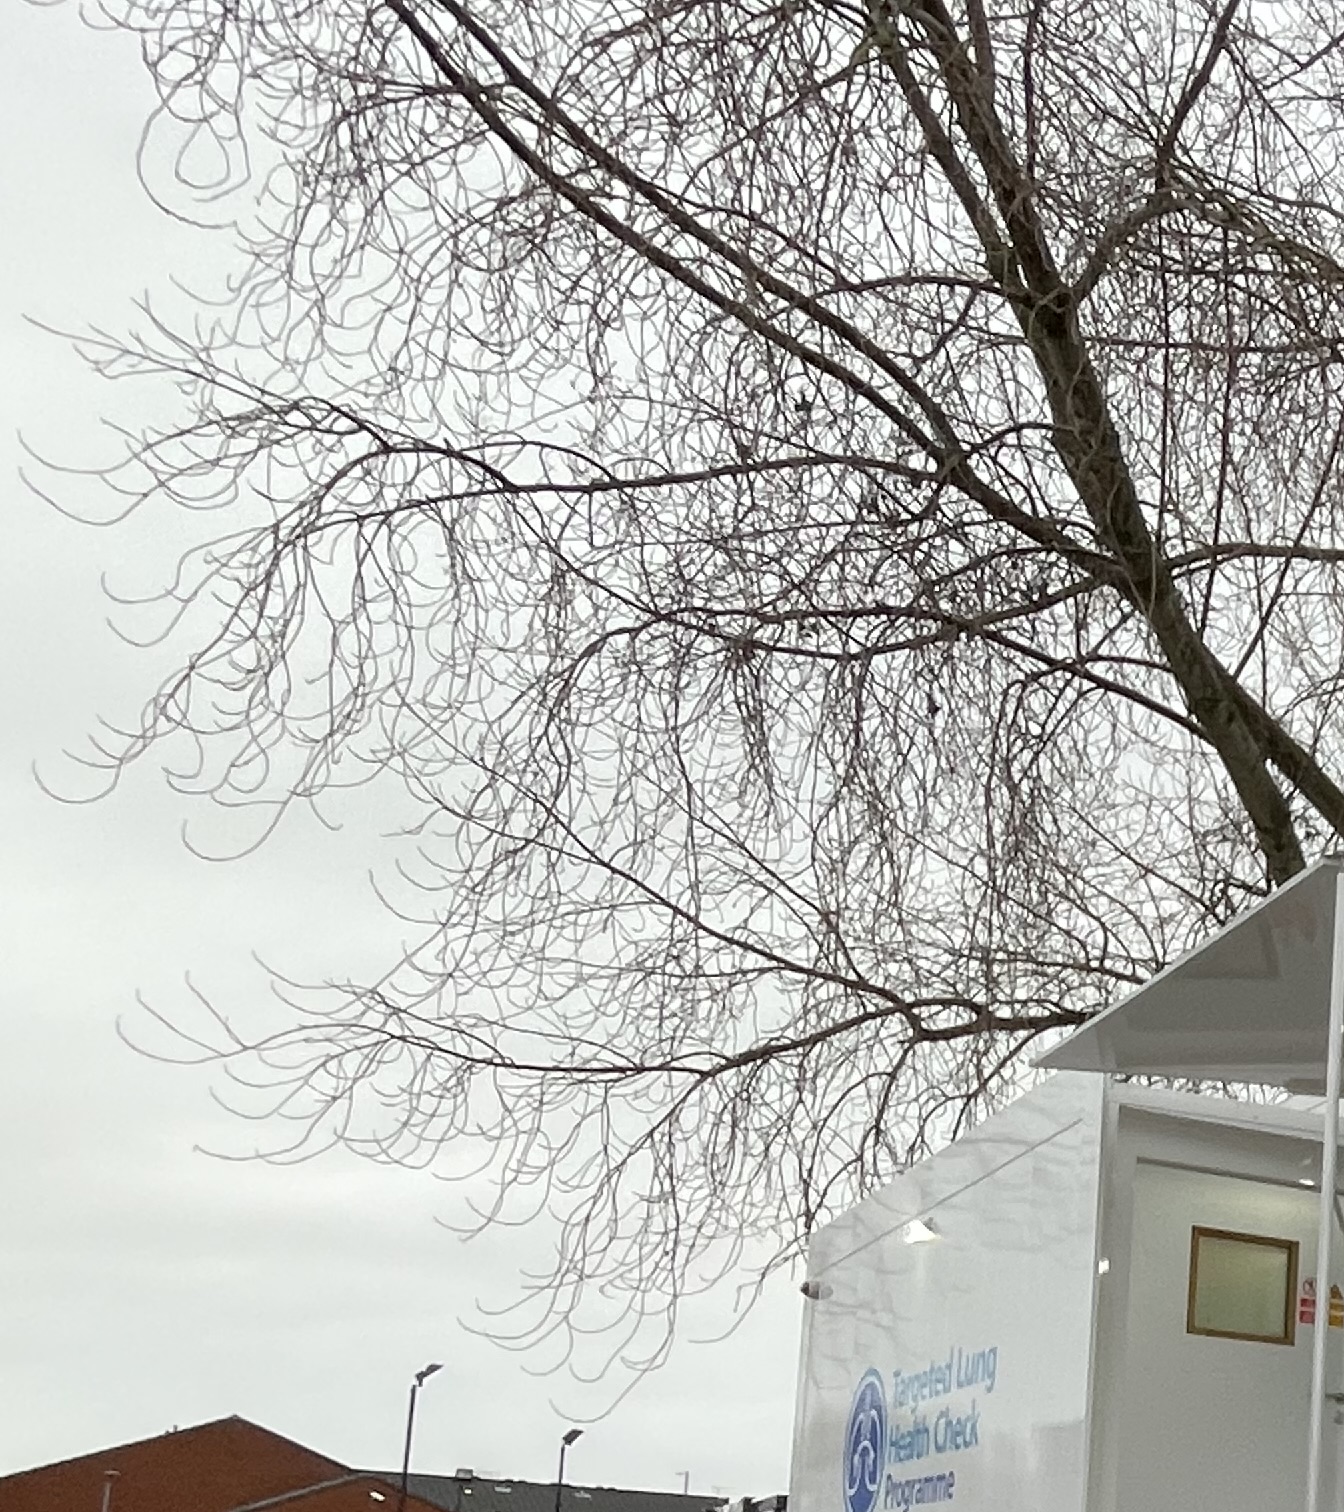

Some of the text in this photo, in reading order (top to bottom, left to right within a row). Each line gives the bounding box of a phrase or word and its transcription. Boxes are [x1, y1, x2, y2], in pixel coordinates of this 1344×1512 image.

[893, 1345, 998, 1415] Targeted Lung
[889, 1398, 980, 1463] Health Check
